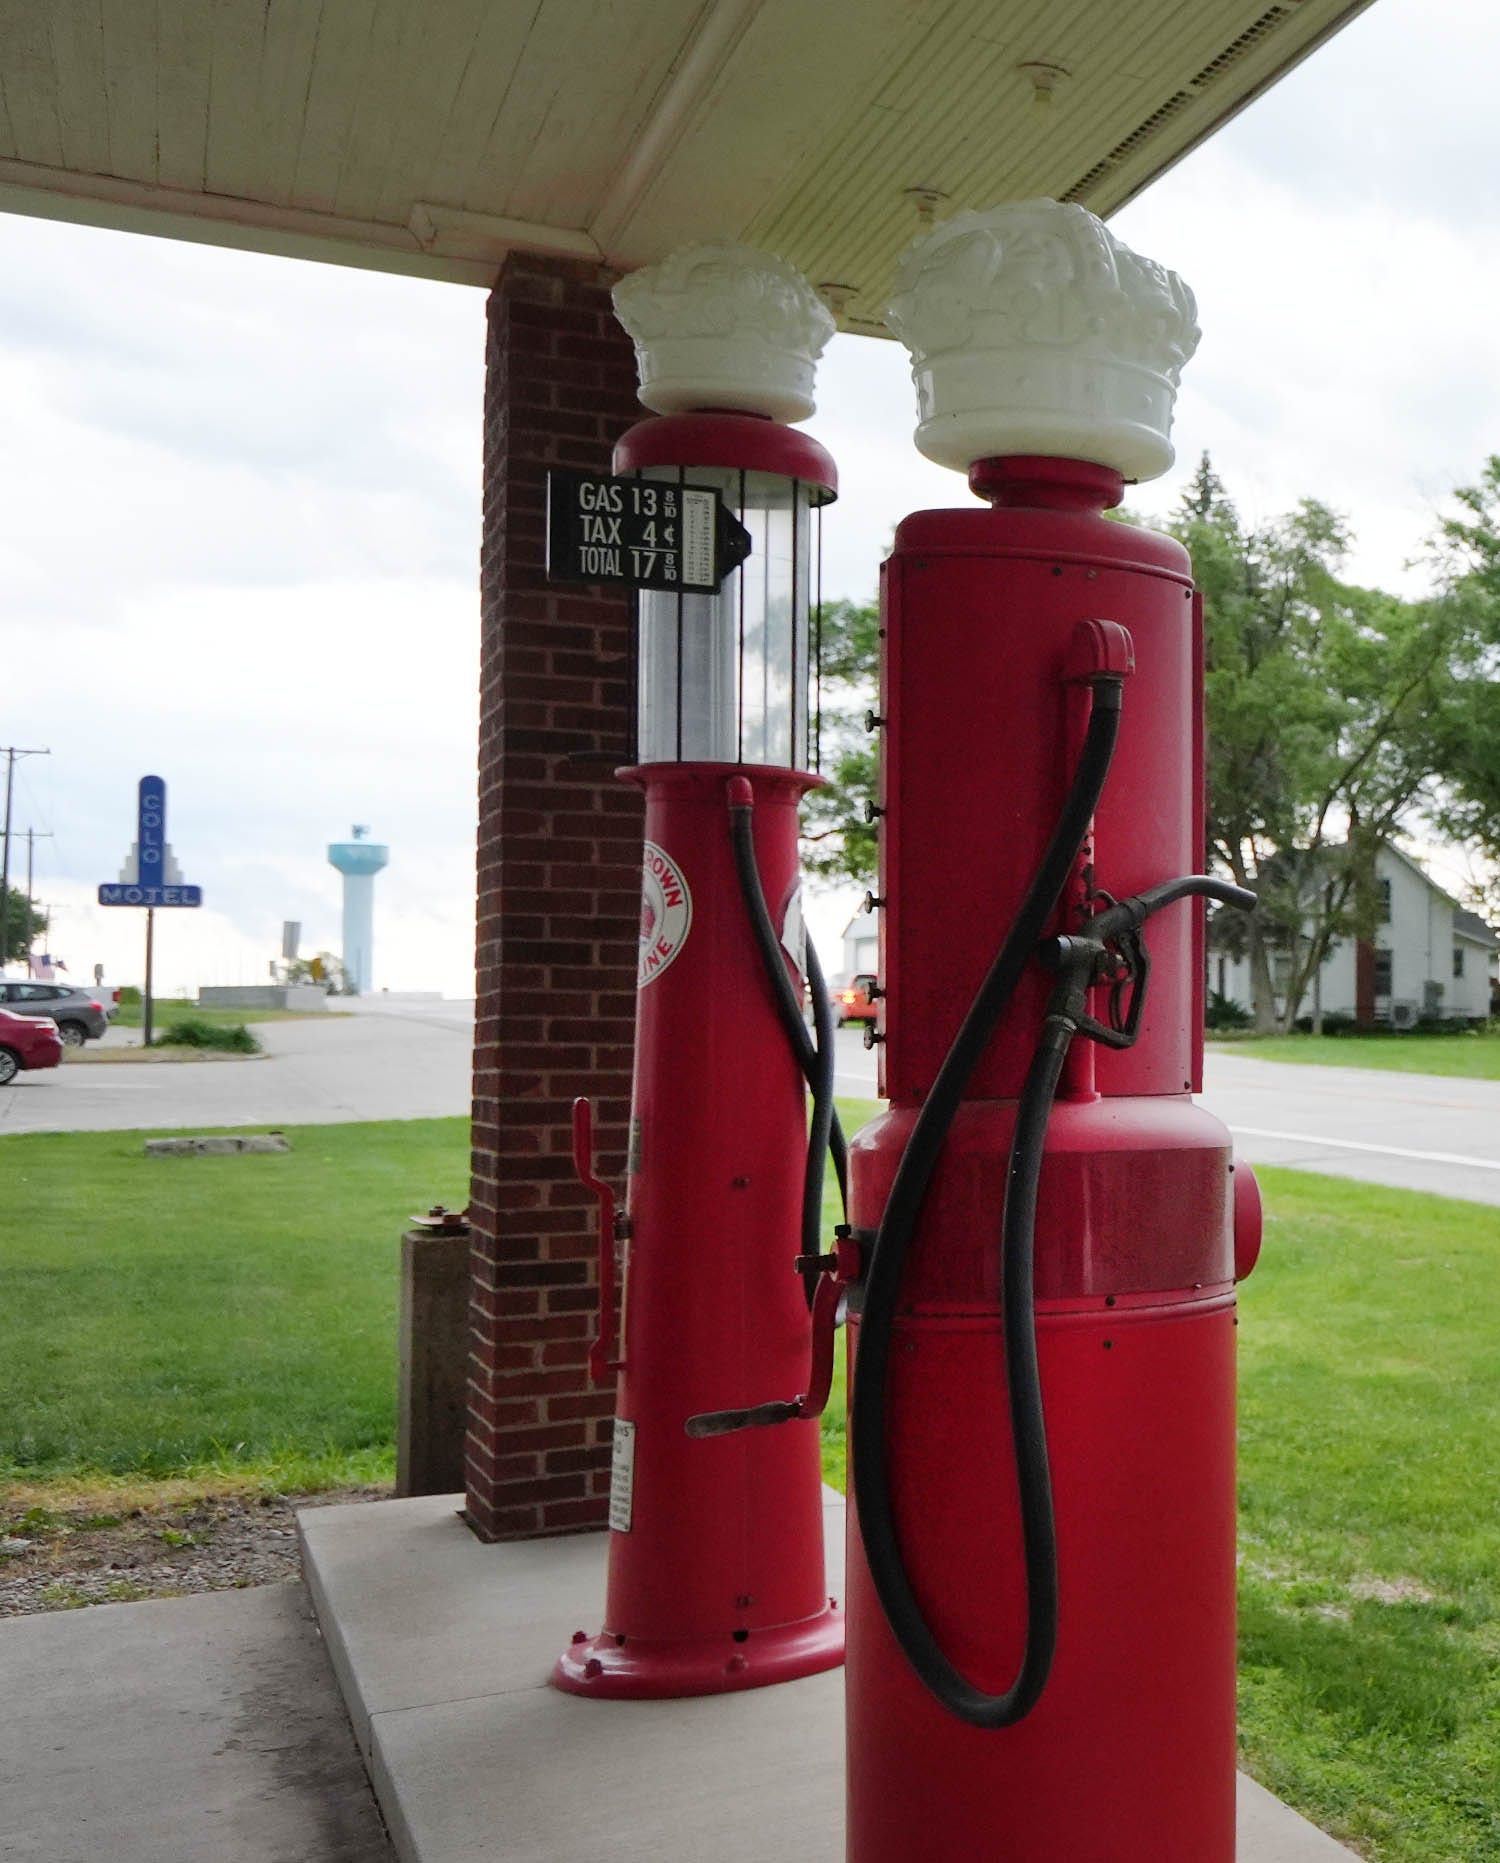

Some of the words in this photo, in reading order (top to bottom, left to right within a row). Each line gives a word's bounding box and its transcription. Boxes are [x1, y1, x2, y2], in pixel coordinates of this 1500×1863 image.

[579, 482, 623, 513] GAS
[632, 487, 657, 516] 13
[579, 515, 622, 545] TAX
[643, 520, 657, 547] 4
[579, 546, 623, 577] TOTAL
[632, 550, 656, 578] 17
[142, 794, 161, 864] COLO
[102, 887, 197, 904] MOTEL
